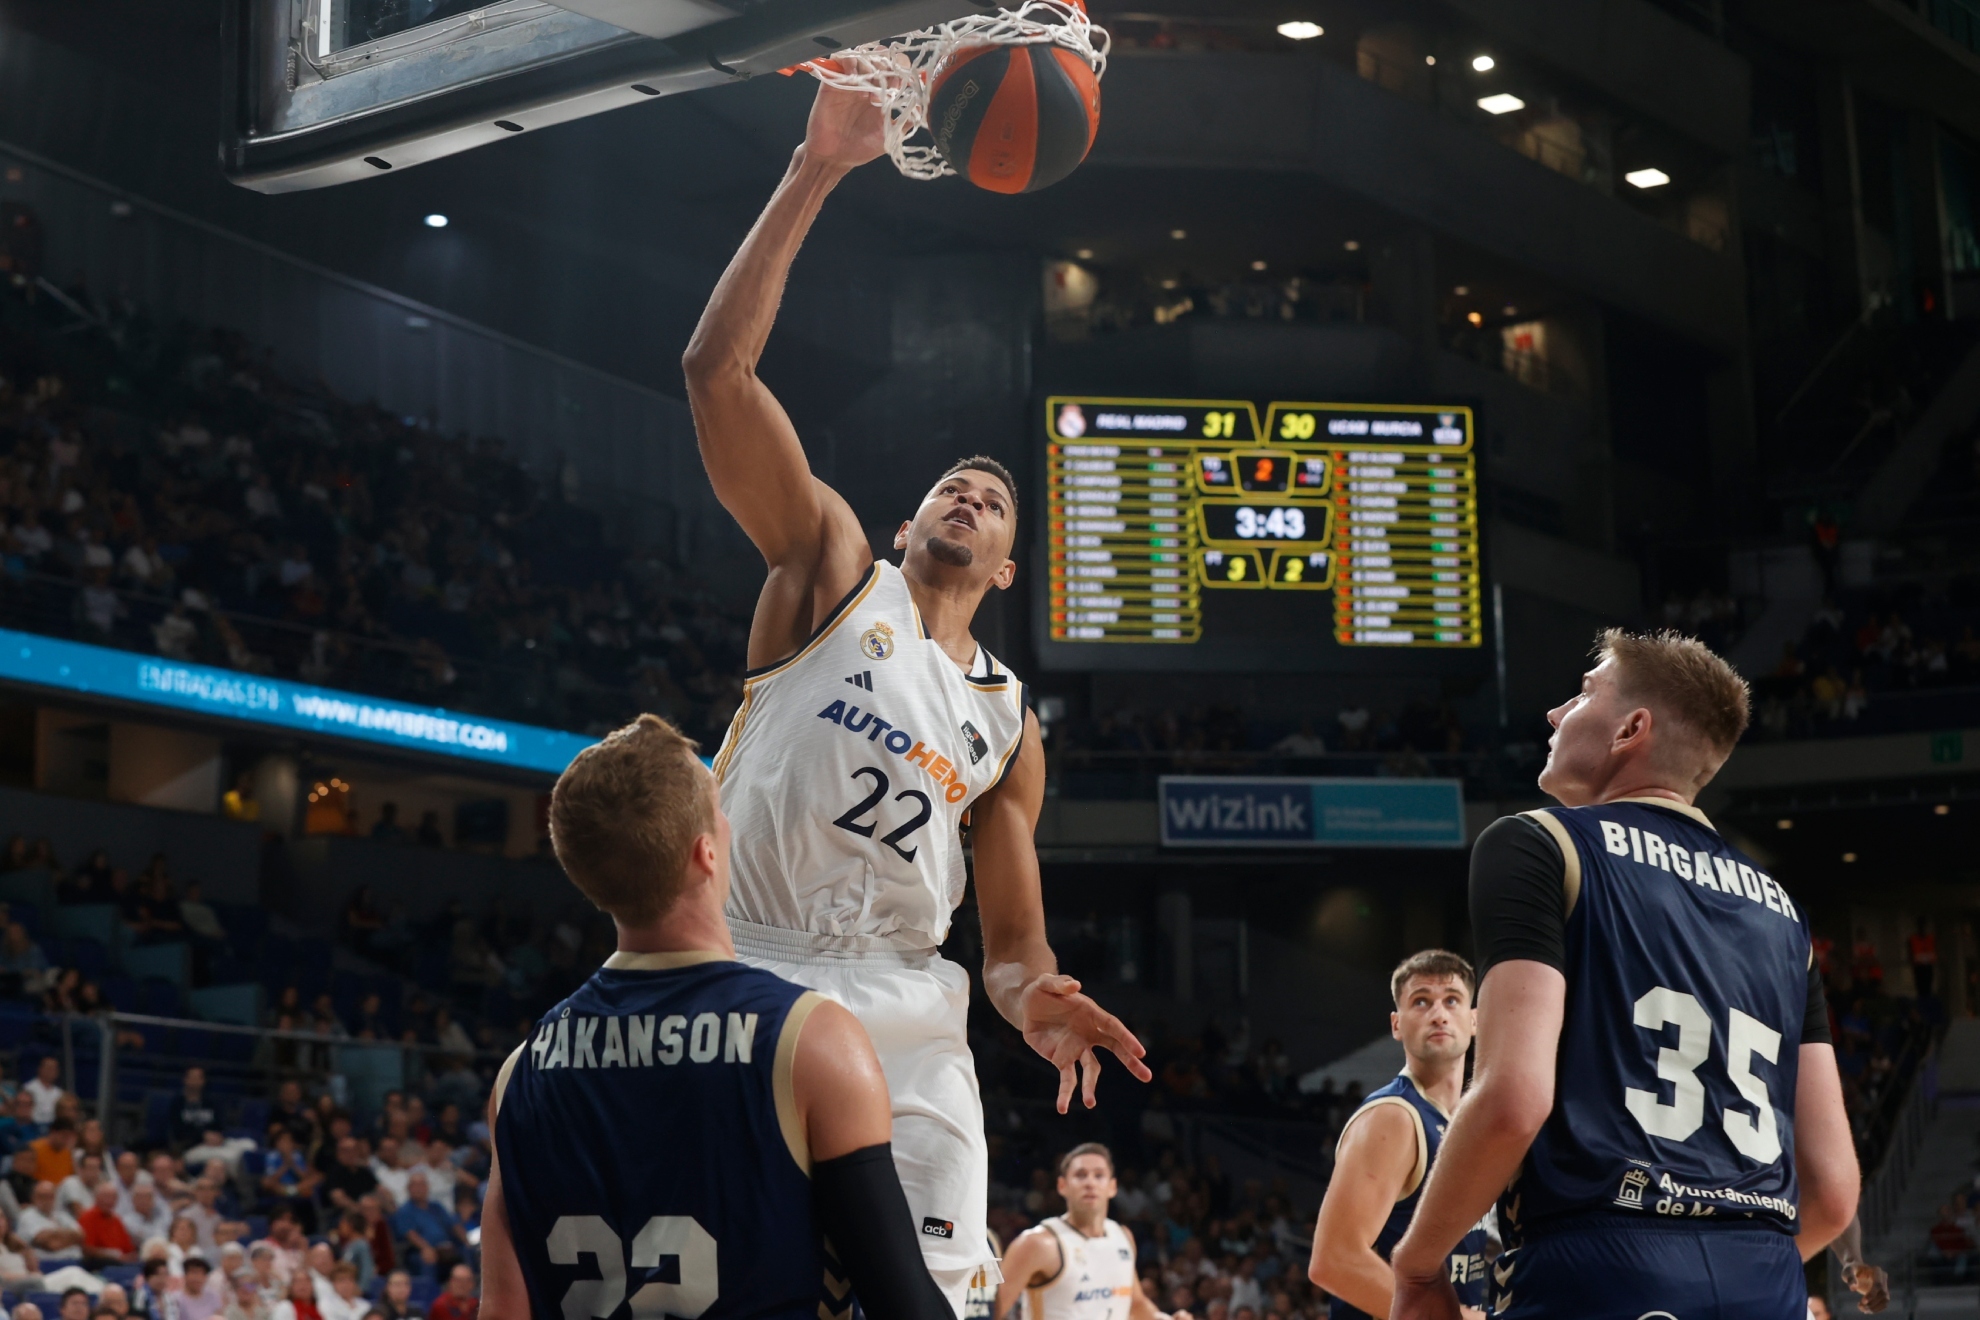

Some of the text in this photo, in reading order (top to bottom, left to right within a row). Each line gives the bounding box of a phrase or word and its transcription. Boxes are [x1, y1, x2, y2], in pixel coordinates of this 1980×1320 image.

[1096, 413, 1187, 431] REAL MADRID
[1202, 411, 1236, 438] 31
[1280, 413, 1316, 439] 30
[1371, 420, 1423, 437] MURCIA
[1254, 458, 1274, 482] 2
[1235, 507, 1305, 540] 3:43
[1227, 556, 1247, 582] 3
[1284, 557, 1304, 582] 2
[817, 699, 968, 804] AUTOHERO
[832, 766, 932, 864] 22
[1168, 793, 1306, 831] WiZink
[1598, 820, 1800, 924] BIRGANDER
[529, 1006, 759, 1071] HÅKANSON
[1624, 985, 1784, 1167] 35
[1655, 1195, 1685, 1216] de
[1658, 1172, 1797, 1221] Ayuntamiento
[924, 1224, 947, 1236] acb
